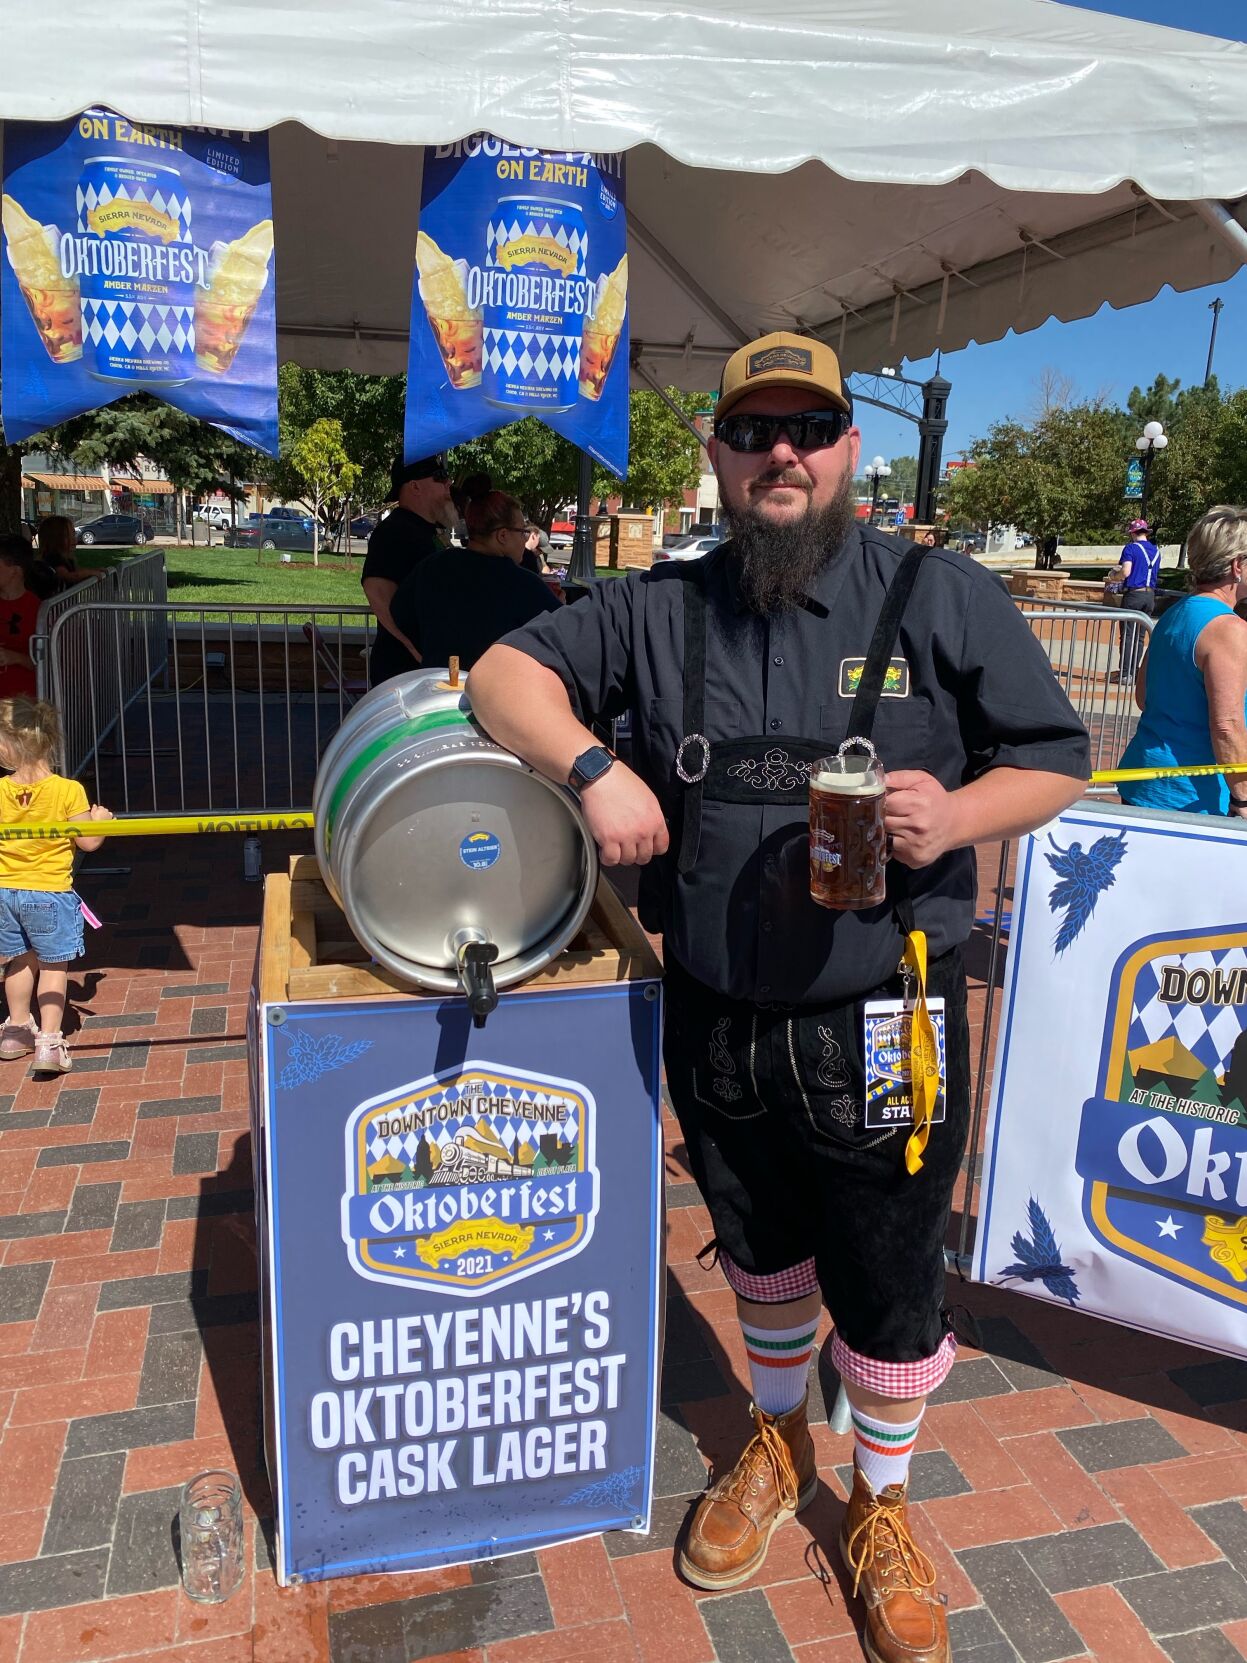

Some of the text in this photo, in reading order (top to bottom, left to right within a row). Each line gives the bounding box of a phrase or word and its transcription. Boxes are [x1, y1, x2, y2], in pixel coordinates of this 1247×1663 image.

[79, 118, 109, 139] ON
[115, 120, 183, 151] EARTH
[206, 156, 239, 173] EDITION
[207, 148, 240, 165] LIMITED
[497, 160, 588, 188] ON EARTH
[98, 211, 168, 230] SIERRA NEVADA
[60, 233, 210, 290] OKTOBERFEST
[507, 247, 568, 264] SIERRA NEVADA
[104, 280, 132, 290] AMBER
[467, 266, 597, 321] OKTOBERFEST
[506, 311, 532, 321] AMBER
[465, 1083, 483, 1095] THE
[887, 1096, 900, 1106] ALL
[378, 1097, 567, 1138] DOWNTOWN CHEYENNE
[1129, 1088, 1241, 1126] AT THE HISTORIC
[369, 1177, 577, 1233] Oktoberfest
[433, 1230, 519, 1252] SIERRA NEVADA
[457, 1255, 494, 1276] 2021
[330, 1290, 611, 1382] CHEYENNE'S
[310, 1353, 626, 1449] OKTOBERFEST
[338, 1419, 607, 1505] CASK LAGER
